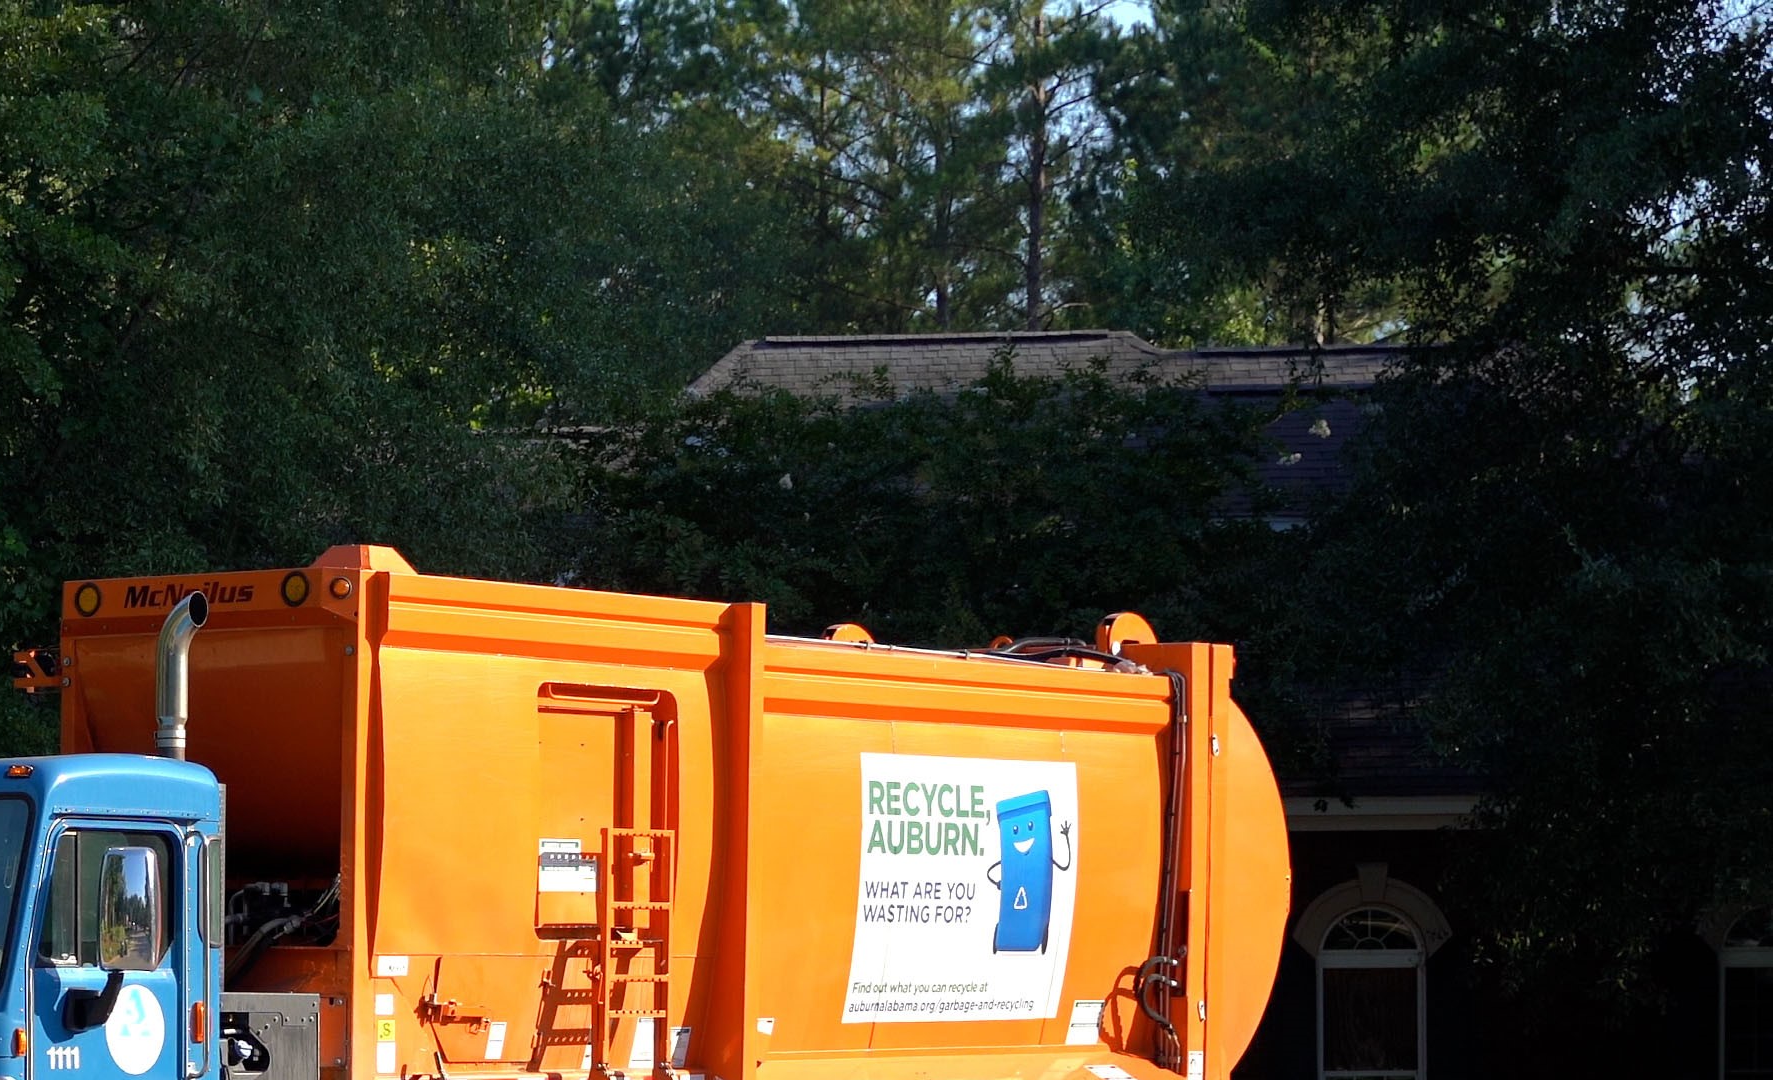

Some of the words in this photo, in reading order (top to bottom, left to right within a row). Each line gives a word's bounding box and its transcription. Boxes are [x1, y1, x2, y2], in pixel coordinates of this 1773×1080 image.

[869, 781, 991, 825] RECYCLE,
[867, 820, 985, 856] AUBURN.
[865, 881, 908, 899] WHAT
[913, 882, 942, 900] ARE
[947, 883, 976, 900] YOU
[863, 905, 930, 923] WASTING
[934, 906, 972, 923] FOR?
[852, 982, 872, 993] Find
[873, 983, 888, 993] out
[890, 982, 912, 993] what
[914, 984, 930, 996] you
[931, 984, 947, 993] can
[948, 981, 978, 995] recycle
[979, 982, 988, 992] at
[46, 1046, 80, 1070] 1111
